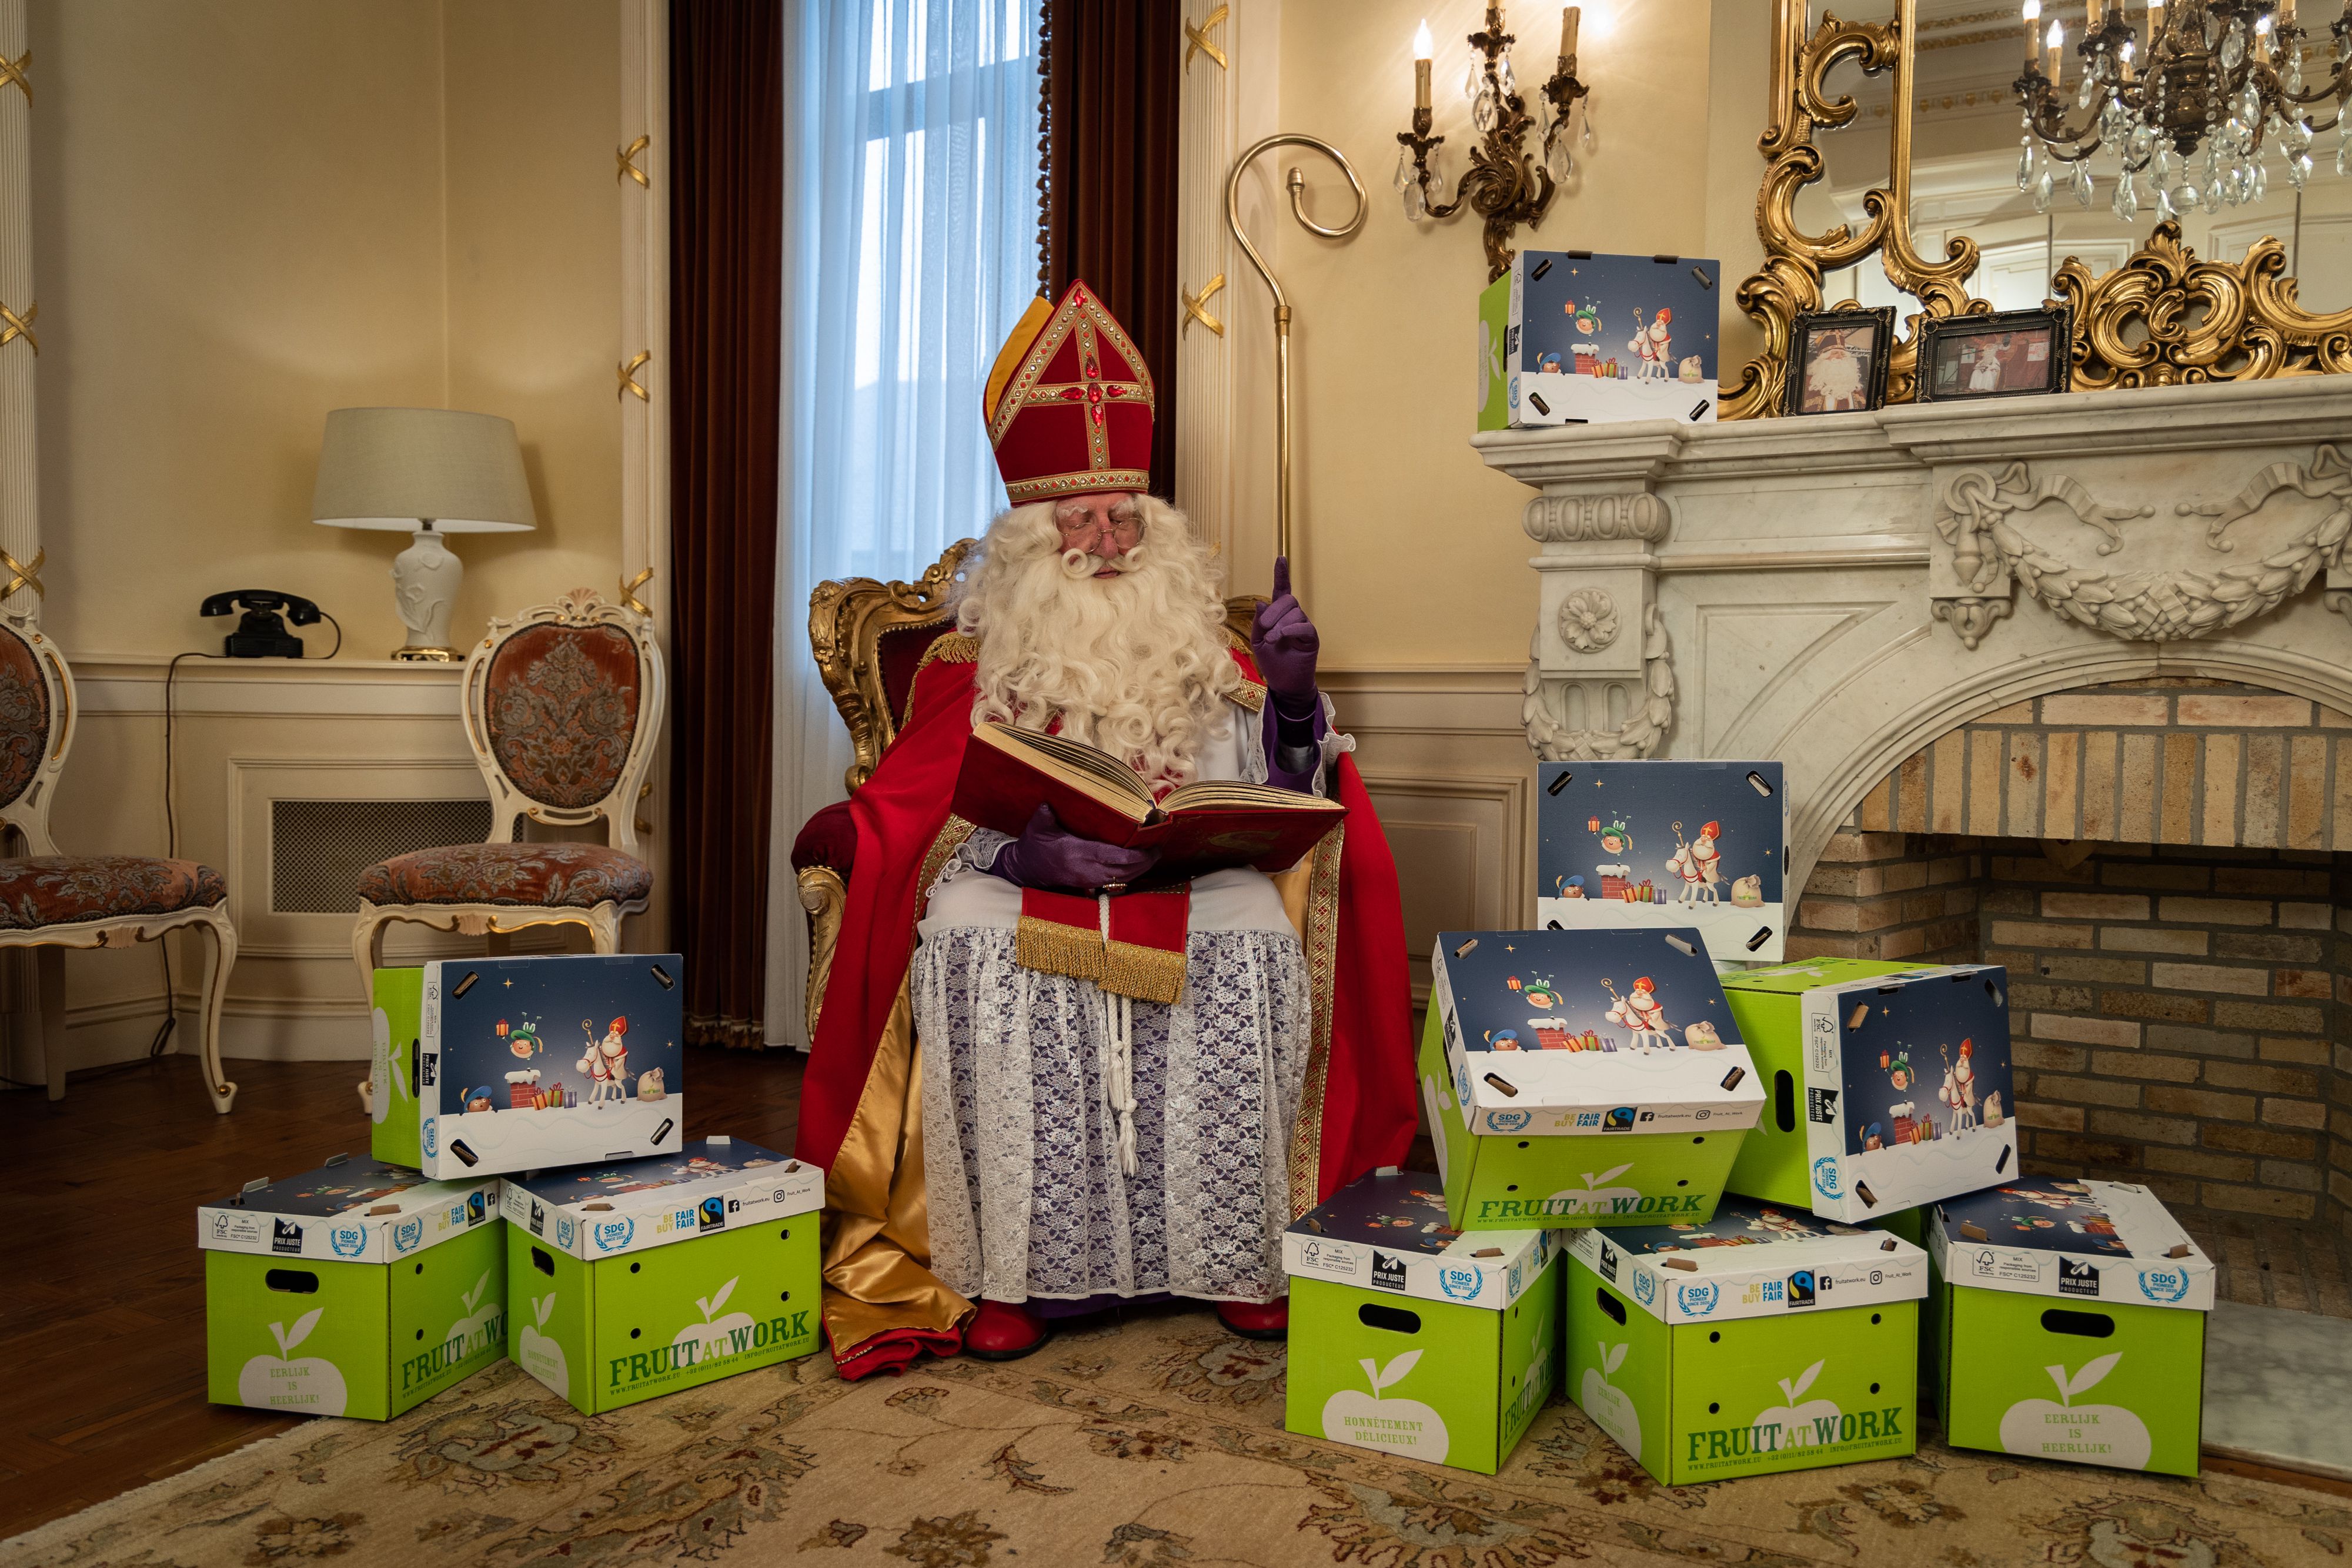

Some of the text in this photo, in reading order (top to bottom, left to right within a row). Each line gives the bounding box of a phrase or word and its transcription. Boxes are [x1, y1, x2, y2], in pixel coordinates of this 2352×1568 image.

[1829, 1167, 1837, 1189] SDG
[787, 1187, 811, 1196] Fruit_At_Work
[742, 1196, 770, 1206] fruitatwork.eu
[1479, 1194, 1706, 1218] FRUIT AT WORK
[443, 1205, 465, 1221] BE FAIR
[663, 1209, 695, 1224] BE FAIR
[438, 1213, 465, 1232] BUY FAIR
[560, 1221, 570, 1233] SDG
[604, 1222, 625, 1235] SDG
[656, 1218, 695, 1234] BUY FAIR
[700, 1221, 724, 1231] FAIRTRADE
[340, 1230, 358, 1240] SDG
[401, 1223, 416, 1235] SDG
[274, 1237, 302, 1246] PRIX JUSTE
[1608, 1263, 1616, 1276] JUSTE
[1885, 1271, 1912, 1279] Fruit_At_Work
[1374, 1271, 1405, 1283] PRIX JUSTE
[1450, 1271, 1472, 1282] SDG
[1638, 1273, 1651, 1288] SDG
[2061, 1277, 2097, 1288] PRIX JUSTE
[2151, 1273, 2177, 1284] SDG
[1373, 1279, 1404, 1289] PRODUCTEUR
[1749, 1281, 1783, 1293] BE FAIR
[2060, 1286, 2097, 1294] PRODUCTEUR
[1688, 1288, 1709, 1298] SDG
[1742, 1292, 1783, 1304] BUY FAIR
[402, 1333, 465, 1392] FRUIT
[466, 1329, 483, 1354] AT
[483, 1310, 509, 1345] WO
[609, 1309, 810, 1388] FRUIT AT WORK
[610, 1372, 681, 1396] WWW.FRUITATWORK.EU
[686, 1367, 698, 1375] +32
[723, 1358, 731, 1366] 58
[731, 1356, 739, 1364] 44
[744, 1336, 810, 1360] INFO@FRUITATWORK.EU
[270, 1367, 310, 1378] EERLIJK
[288, 1382, 297, 1390] IS
[269, 1394, 320, 1405] HEERLIJK!
[1344, 1416, 1423, 1432] HONNÊTEMENT
[2044, 1414, 2100, 1424] EERLIJK
[1355, 1430, 1417, 1445] DÉLICIEUX!
[1688, 1406, 1903, 1462] FRUIT AT WORK
[2069, 1429, 2082, 1438] IS
[2042, 1443, 2112, 1453] HEERLIJK!
[1688, 1456, 1762, 1472] WWW.FRUITATWORK.EU
[1830, 1437, 1903, 1454] INFO@FRUITATWORK.EU
